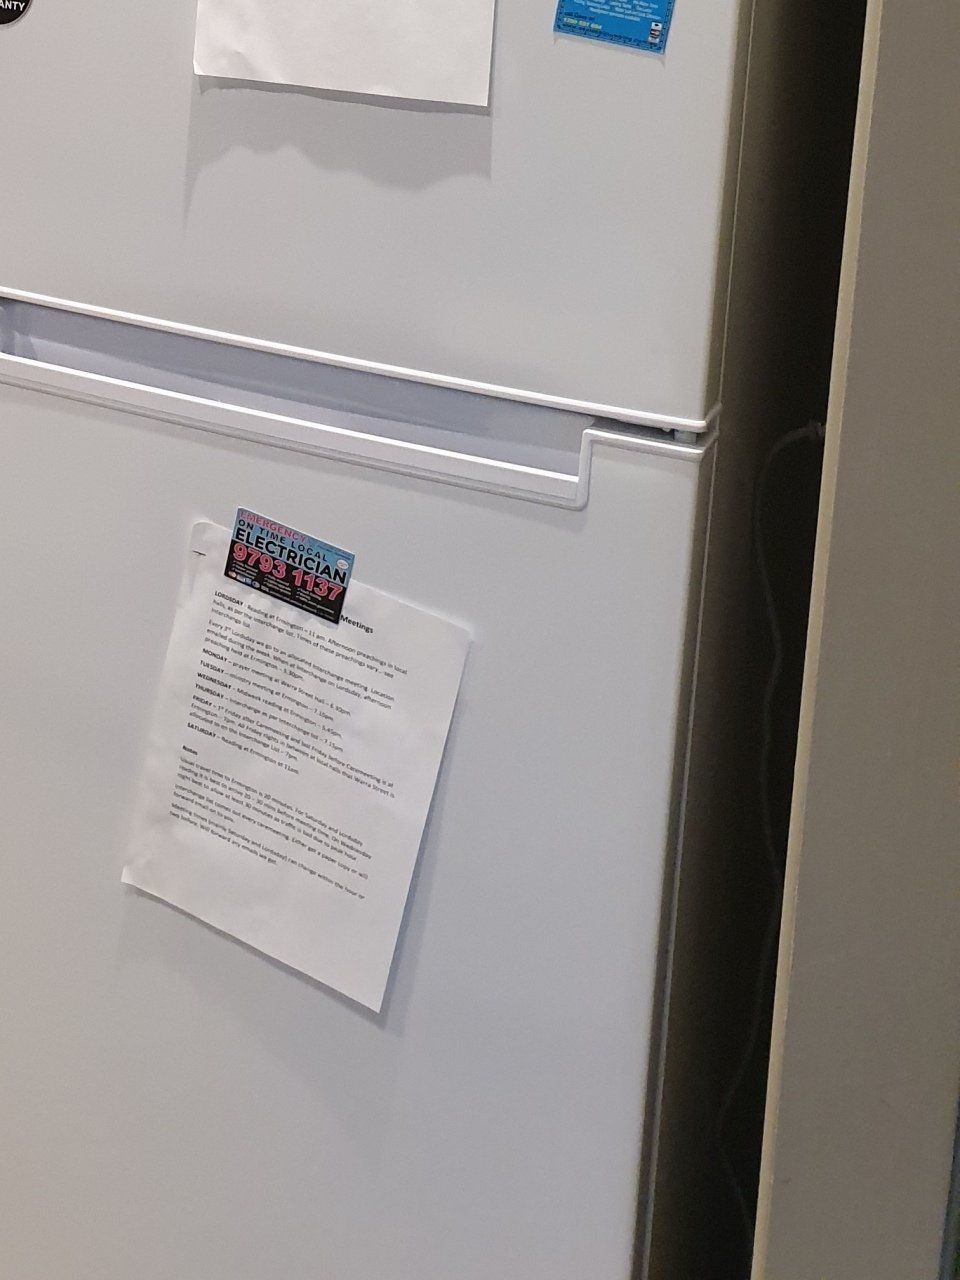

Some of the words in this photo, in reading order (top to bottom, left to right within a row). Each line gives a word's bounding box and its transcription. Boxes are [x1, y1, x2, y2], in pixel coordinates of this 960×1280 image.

[238, 519, 254, 530] ON
[260, 526, 286, 544] TIME
[291, 541, 327, 561] LOCAL
[240, 511, 306, 543] EMERGENCY
[233, 543, 287, 579] 9793
[292, 569, 343, 601] 1137
[235, 527, 347, 585] ELECTRICIAN
[339, 615, 375, 634] Meetings
[199, 660, 225, 674] TUESDAY
[202, 648, 228, 662] MONDAY
